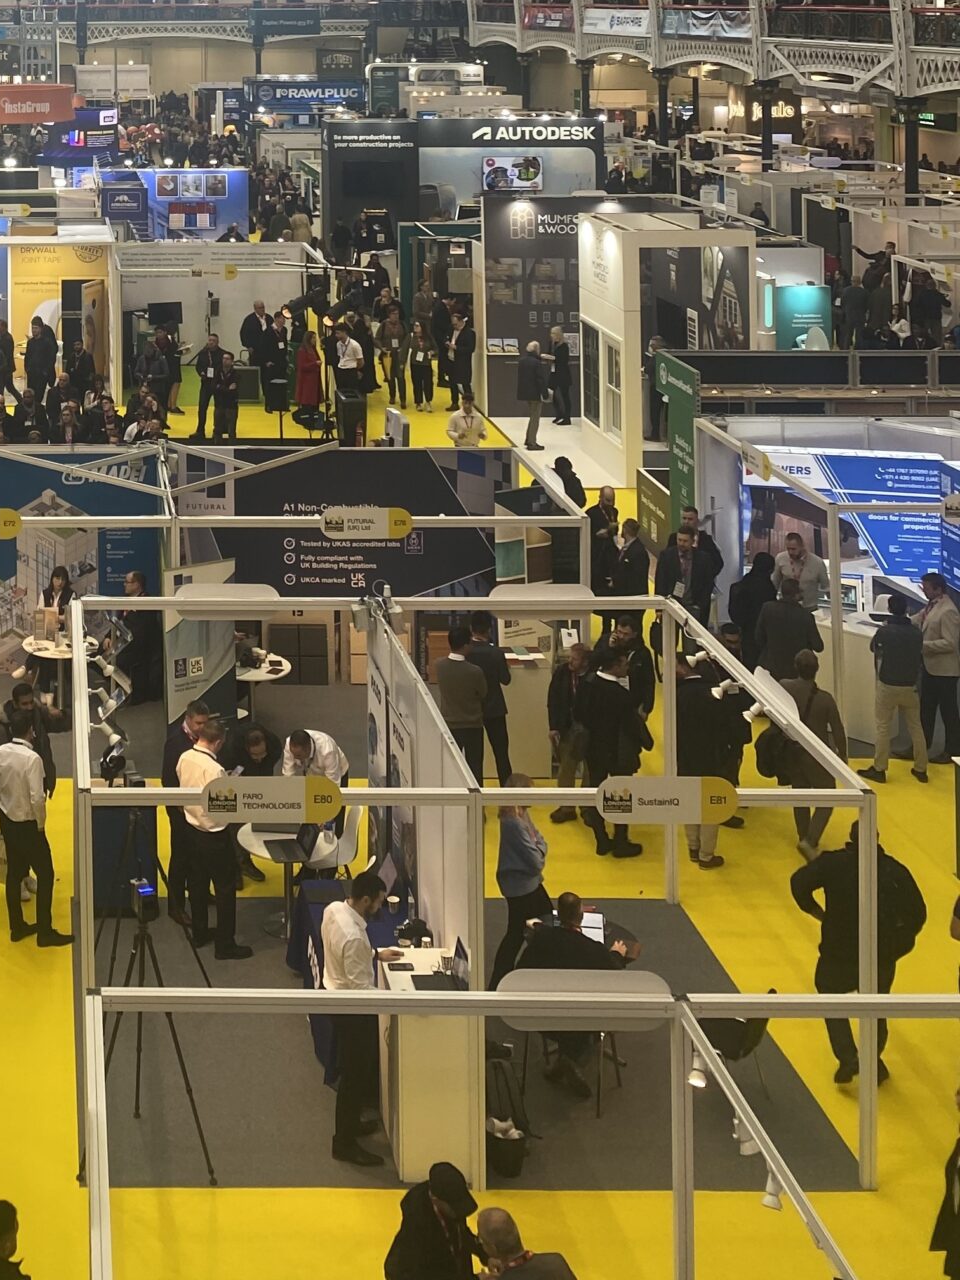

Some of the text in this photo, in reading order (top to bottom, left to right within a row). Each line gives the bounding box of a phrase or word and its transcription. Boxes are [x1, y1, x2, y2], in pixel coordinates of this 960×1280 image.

[288, 88, 358, 98] RAWLPLUG
[4, 102, 50, 114] InstaGroup
[495, 126, 596, 140] AUTODESK
[20, 246, 56, 254] DRYWALL
[282, 504, 295, 512] A1
[900, 515, 940, 524] commercial
[322, 540, 330, 548] by
[300, 554, 316, 562] Fully
[316, 554, 348, 562] compliant
[312, 562, 338, 570] Building
[340, 562, 377, 570] Regulations
[350, 572, 366, 580] UK
[190, 666, 202, 674] CA
[314, 794, 332, 804] E80
[638, 796, 727, 806] SustainIQ E81
[242, 802, 302, 810] TECHNOLOGIES
